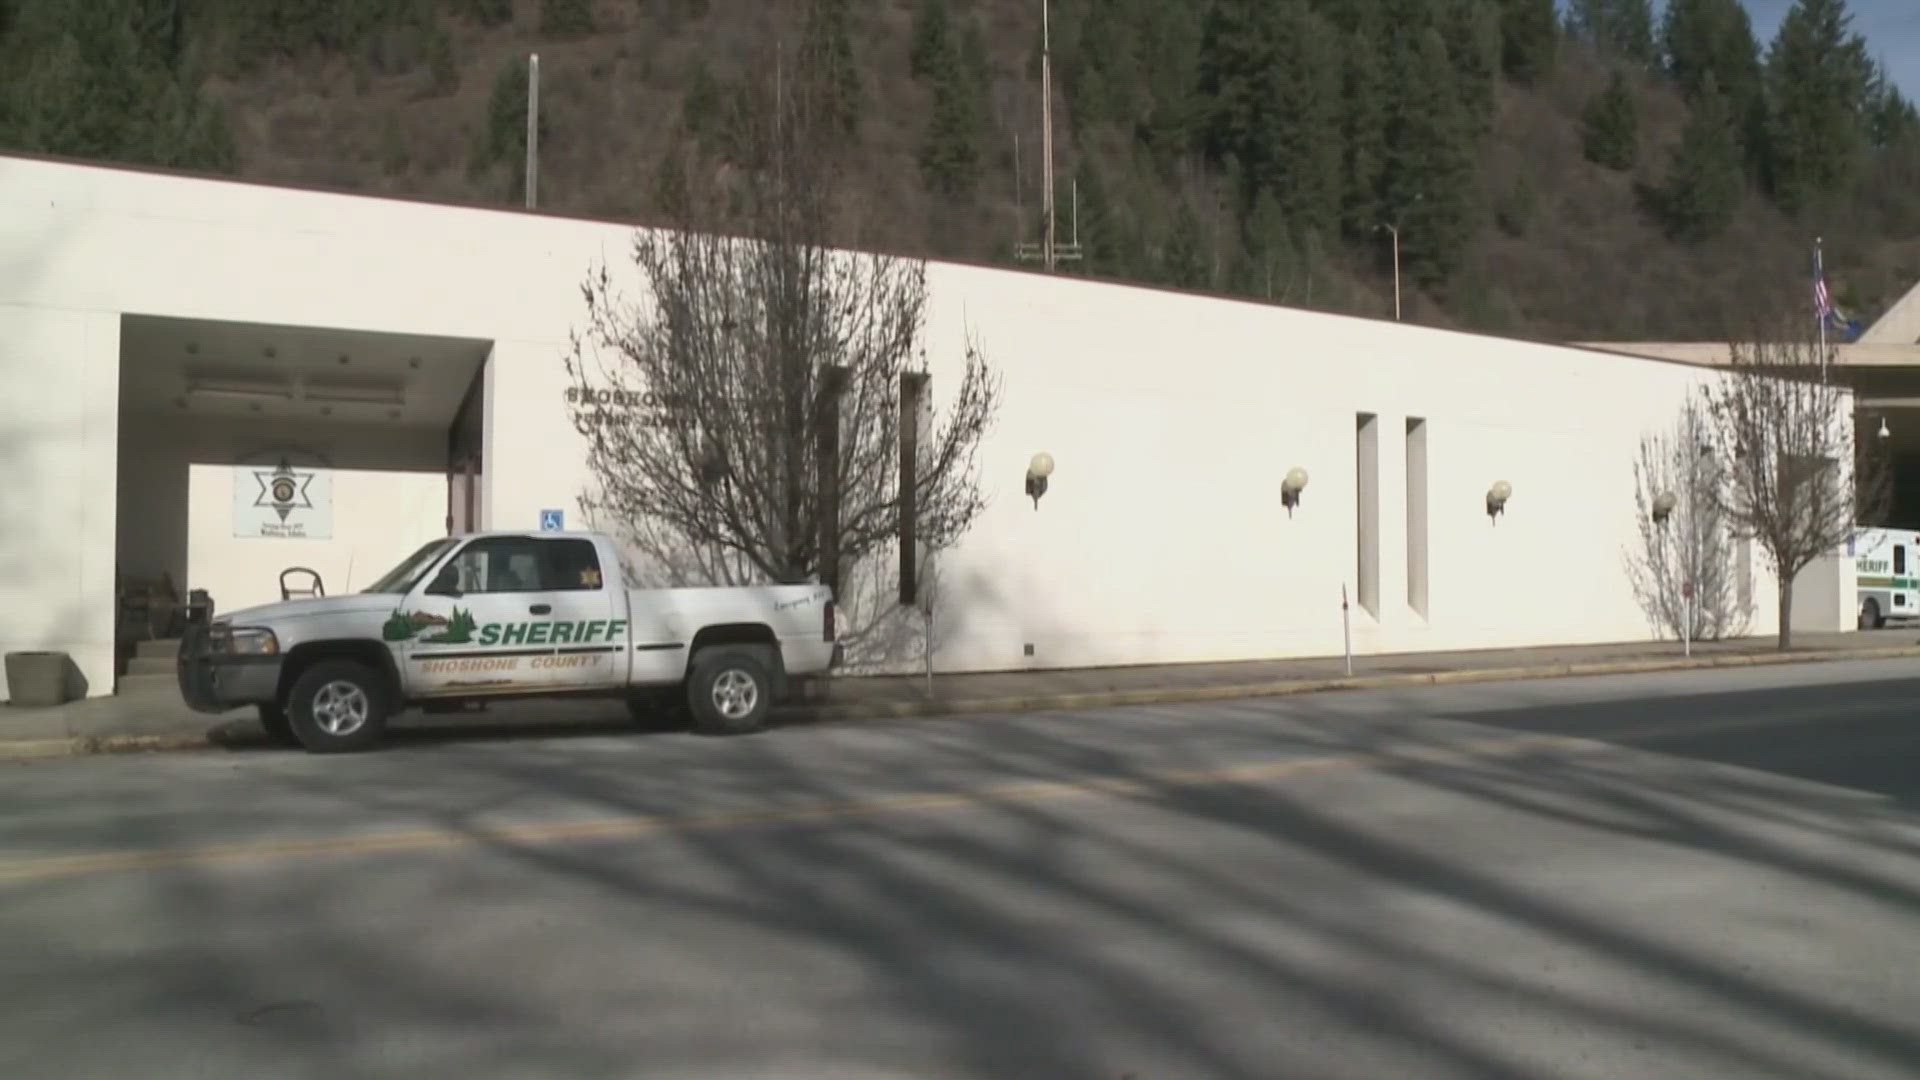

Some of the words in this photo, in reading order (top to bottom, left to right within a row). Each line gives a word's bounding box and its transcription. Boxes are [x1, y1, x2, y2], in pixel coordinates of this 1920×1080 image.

[1856, 560, 1889, 573] HERIFF
[479, 619, 627, 646] SHERIFF
[422, 657, 519, 674] SHOSHONE
[531, 655, 601, 670] COUNTY
